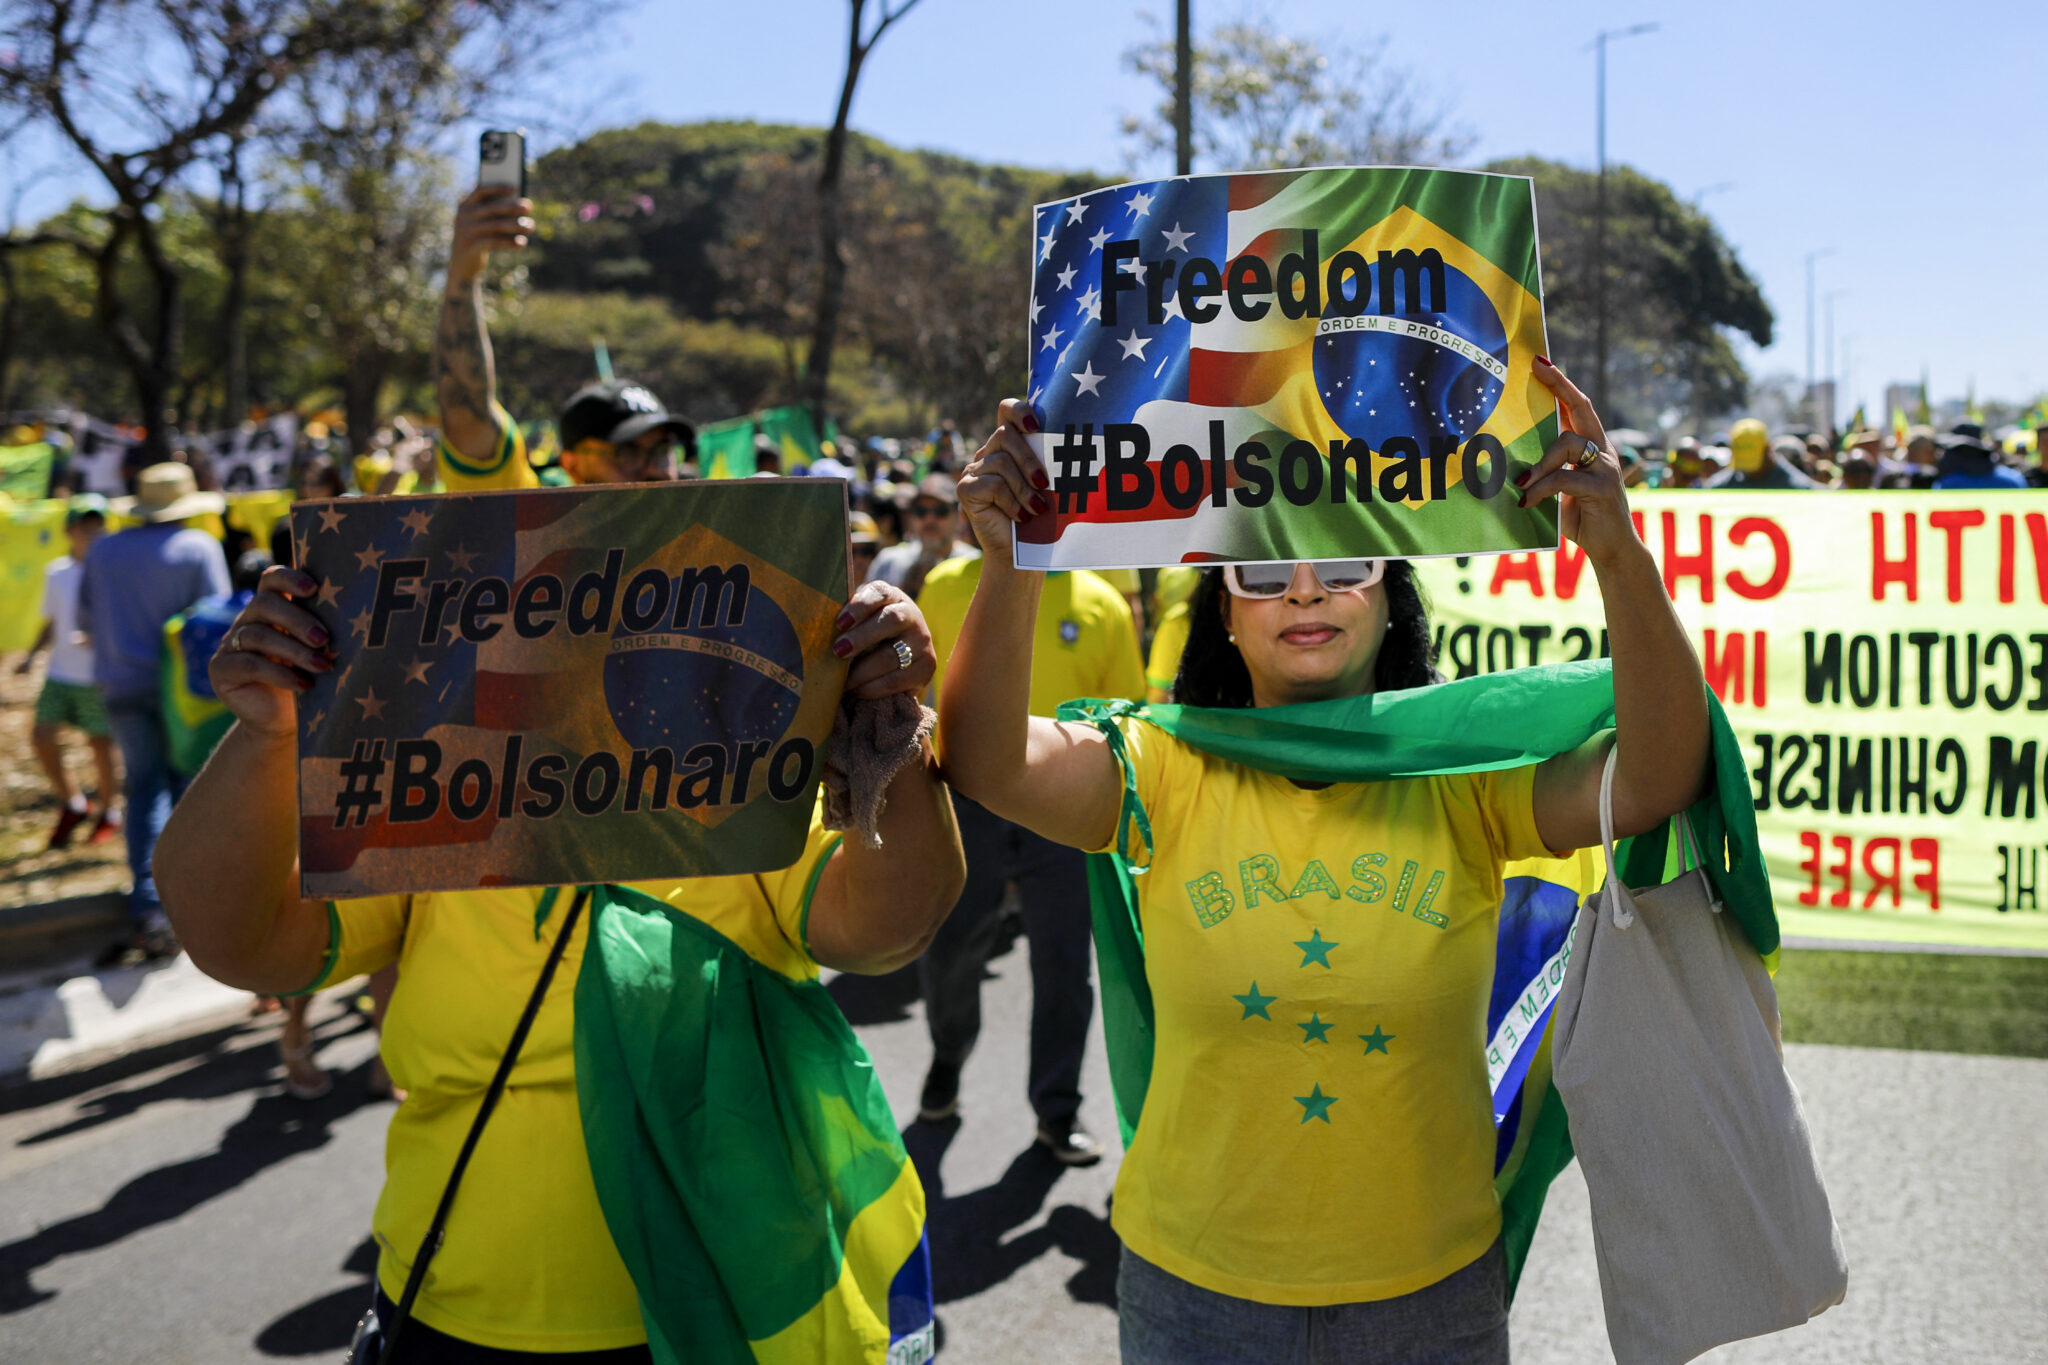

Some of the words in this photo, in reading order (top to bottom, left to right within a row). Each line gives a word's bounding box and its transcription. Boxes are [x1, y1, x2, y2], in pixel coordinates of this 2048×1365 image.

[1100, 228, 1447, 327] Freedom
[1320, 317, 1379, 333] ORDEM
[1387, 320, 1398, 332] E
[1406, 323, 1504, 376] PROGRESSO
[1052, 420, 1508, 515] #Bolsonaro
[364, 547, 752, 650] Freedom
[611, 635, 671, 651] ORDEM
[680, 637, 690, 649] E
[700, 639, 800, 691] PROGRESSO
[331, 735, 816, 830] #Bolsonaro
[1185, 852, 1450, 930] BRASIL
